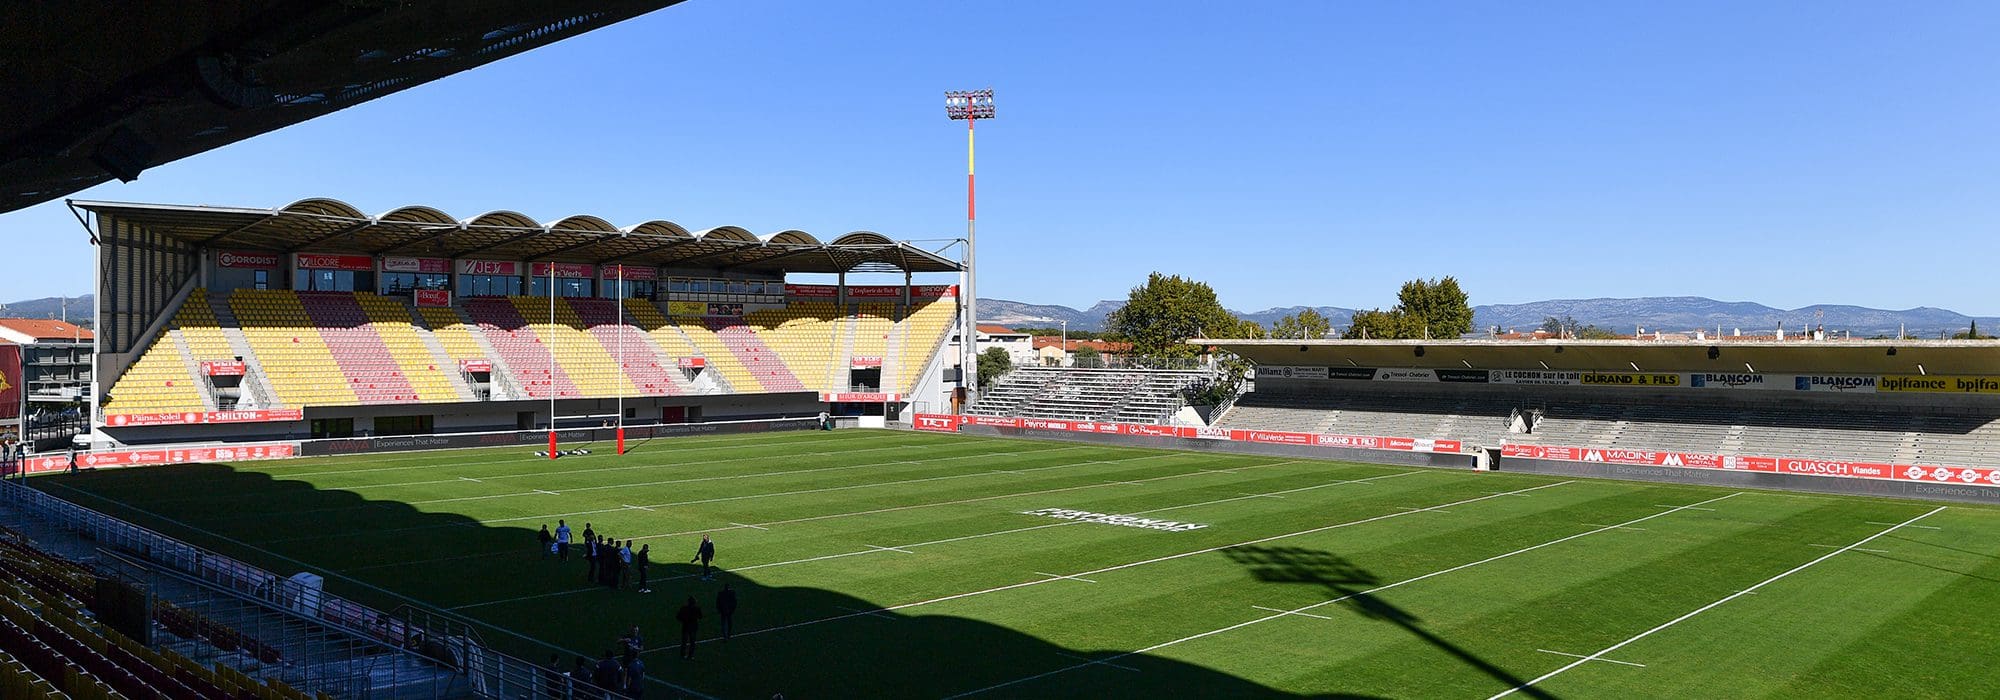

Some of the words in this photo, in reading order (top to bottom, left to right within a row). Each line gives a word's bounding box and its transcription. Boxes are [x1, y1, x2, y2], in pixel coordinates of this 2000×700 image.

[231, 256, 277, 265] SORODIST
[1258, 367, 1282, 376] Allianz
[1513, 371, 1541, 379] COCHON
[1584, 374, 1633, 384] DURAND
[1638, 375, 1647, 384] &
[1653, 375, 1676, 384] FILS
[1706, 374, 1763, 383] BLANCOM
[1811, 376, 1875, 386] BLANCOM
[1882, 377, 1946, 391] bpifrance
[215, 411, 256, 420] SHILTON
[1024, 419, 1047, 429] Peyrot
[328, 441, 369, 450] AVAYA
[376, 439, 413, 448] Experiences
[415, 438, 428, 446] That
[1319, 437, 1349, 445] DURAND
[1361, 438, 1376, 446] FILS
[1607, 450, 1656, 460] MADINE
[1788, 460, 1848, 474] GUASCH
[1852, 466, 1881, 475] Viandes
[1915, 484, 1977, 497] Experiences
